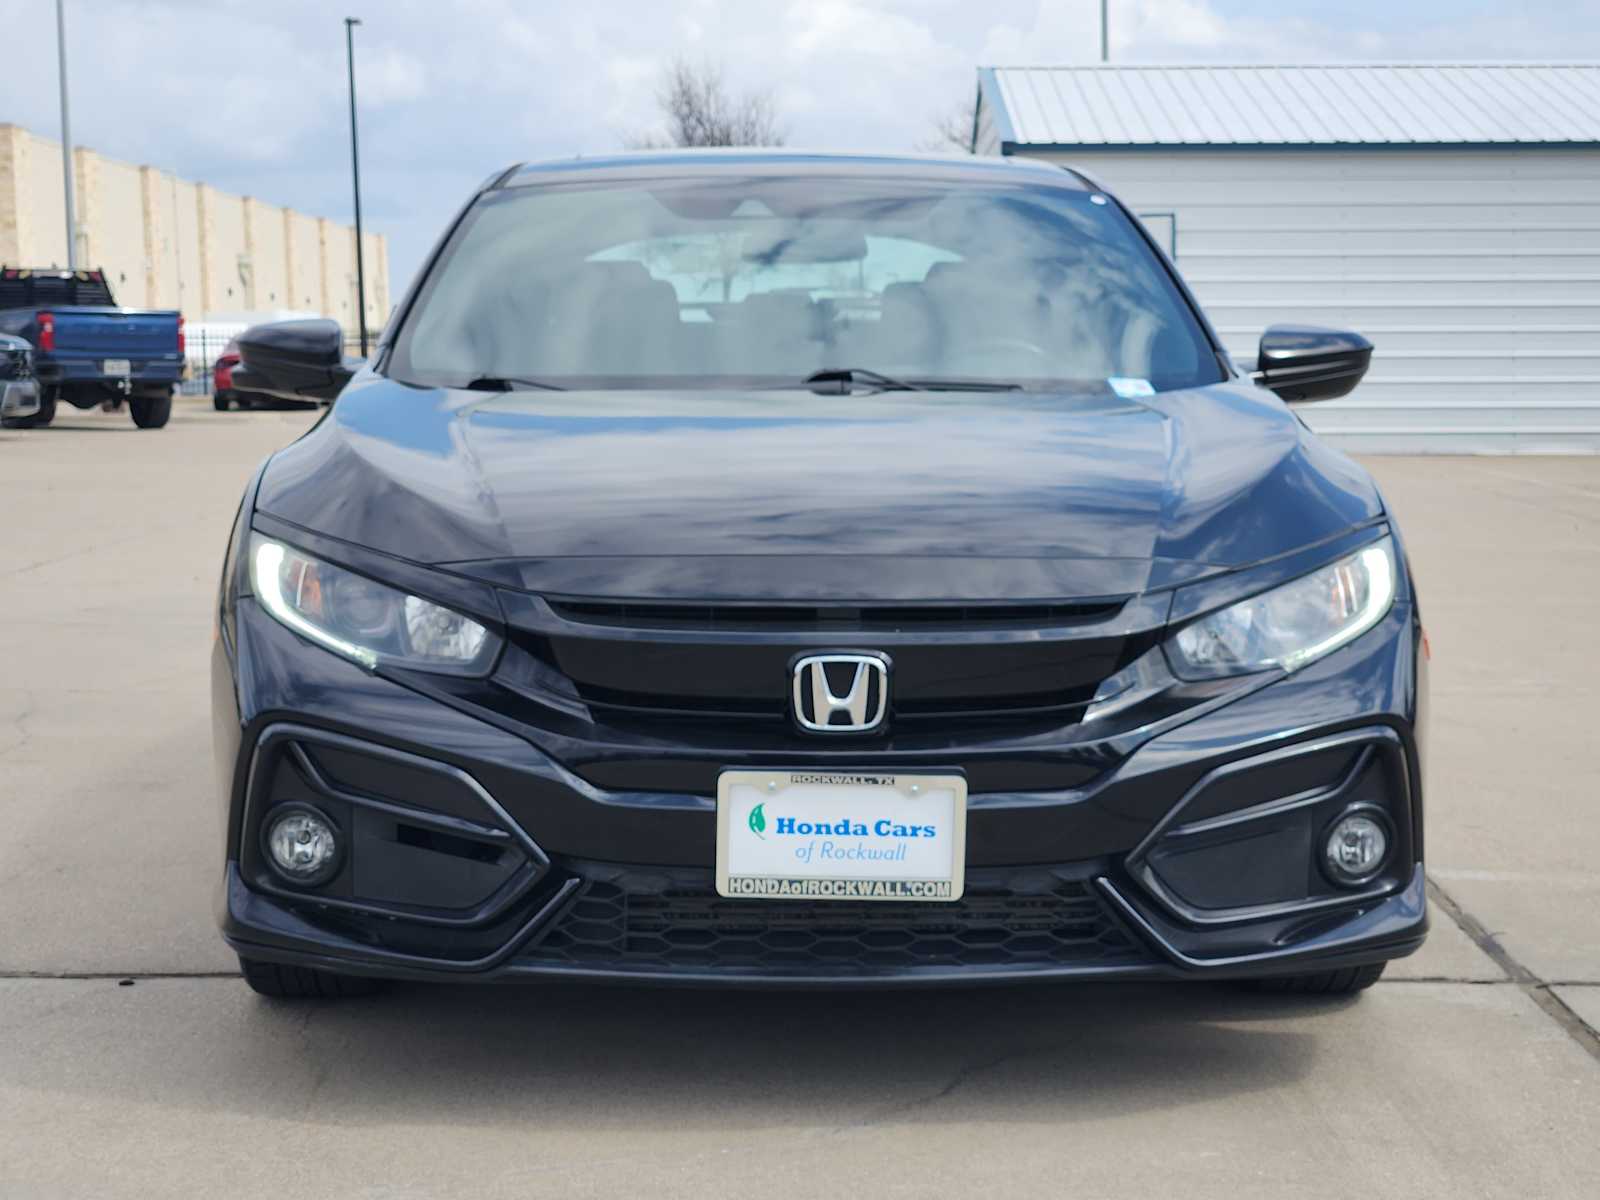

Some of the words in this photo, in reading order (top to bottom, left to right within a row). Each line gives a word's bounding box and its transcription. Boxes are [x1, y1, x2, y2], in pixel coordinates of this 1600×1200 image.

[876, 776, 895, 786] TX
[776, 817, 868, 837] Honda
[874, 819, 936, 838] Cars
[795, 841, 815, 864] of
[820, 841, 907, 862] Rockwall
[729, 878, 951, 897] HONDAofROCKWALL.COM
